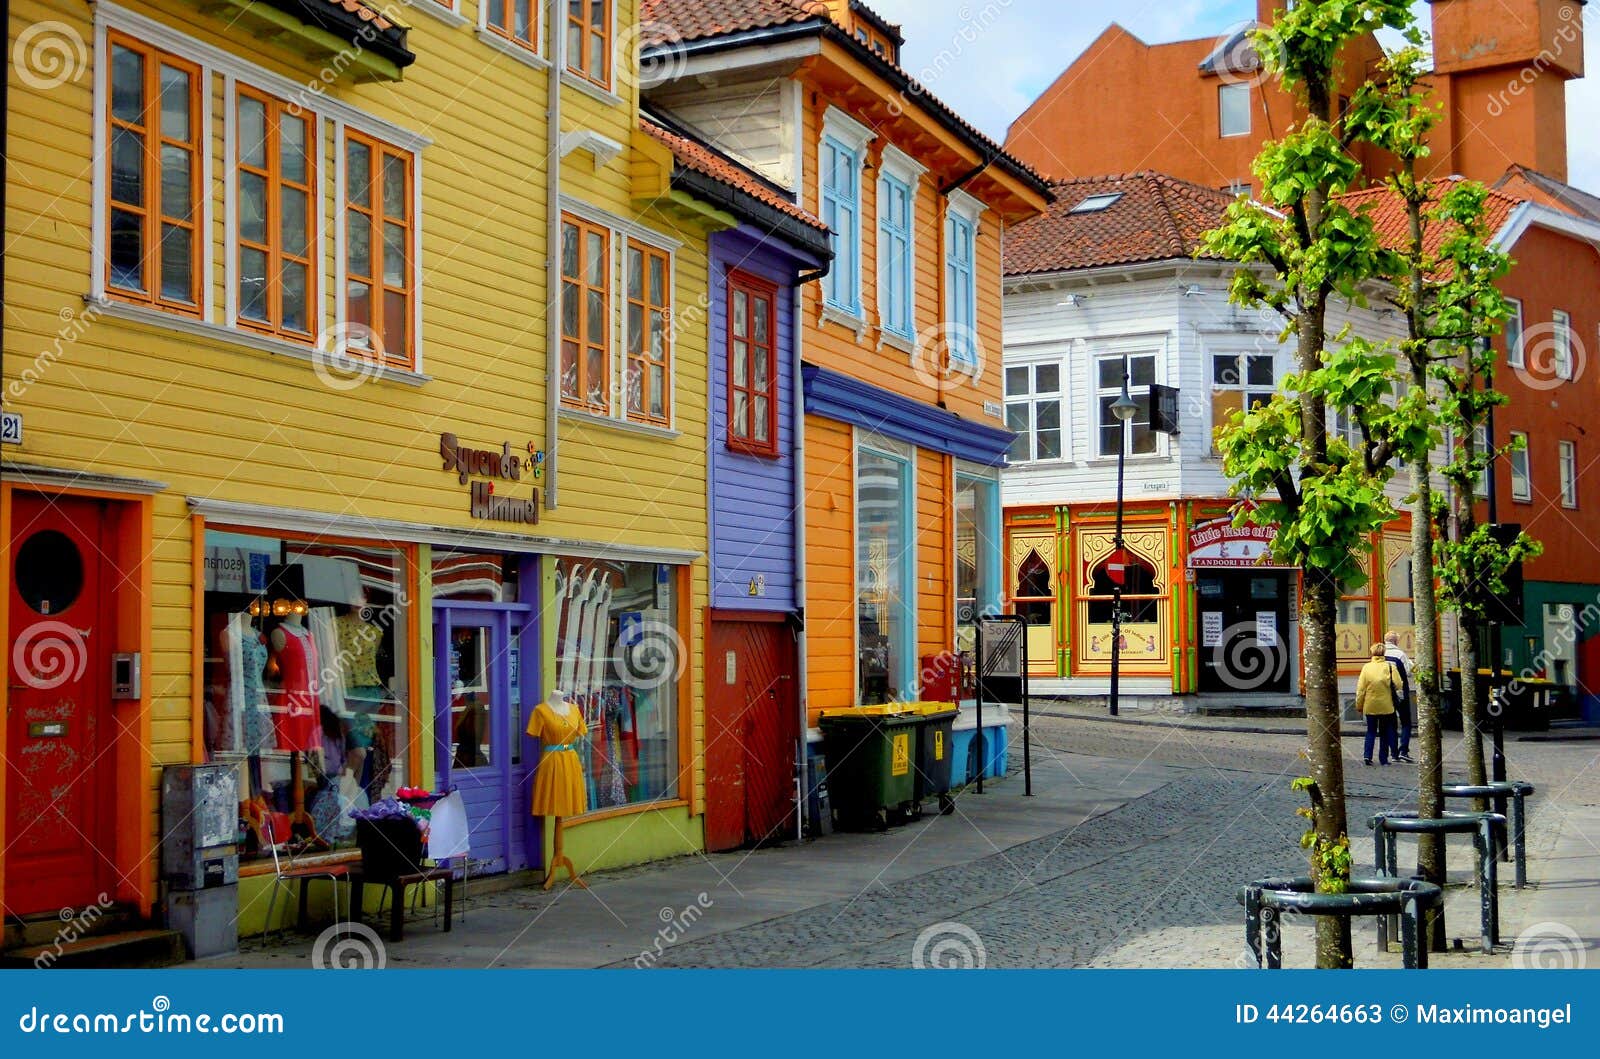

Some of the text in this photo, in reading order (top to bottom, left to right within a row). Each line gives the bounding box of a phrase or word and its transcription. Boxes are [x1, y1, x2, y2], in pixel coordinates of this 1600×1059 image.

[3, 417, 18, 439] 21
[471, 480, 539, 525] Himmel
[1191, 527, 1221, 547] Little
[1252, 526, 1265, 538] of
